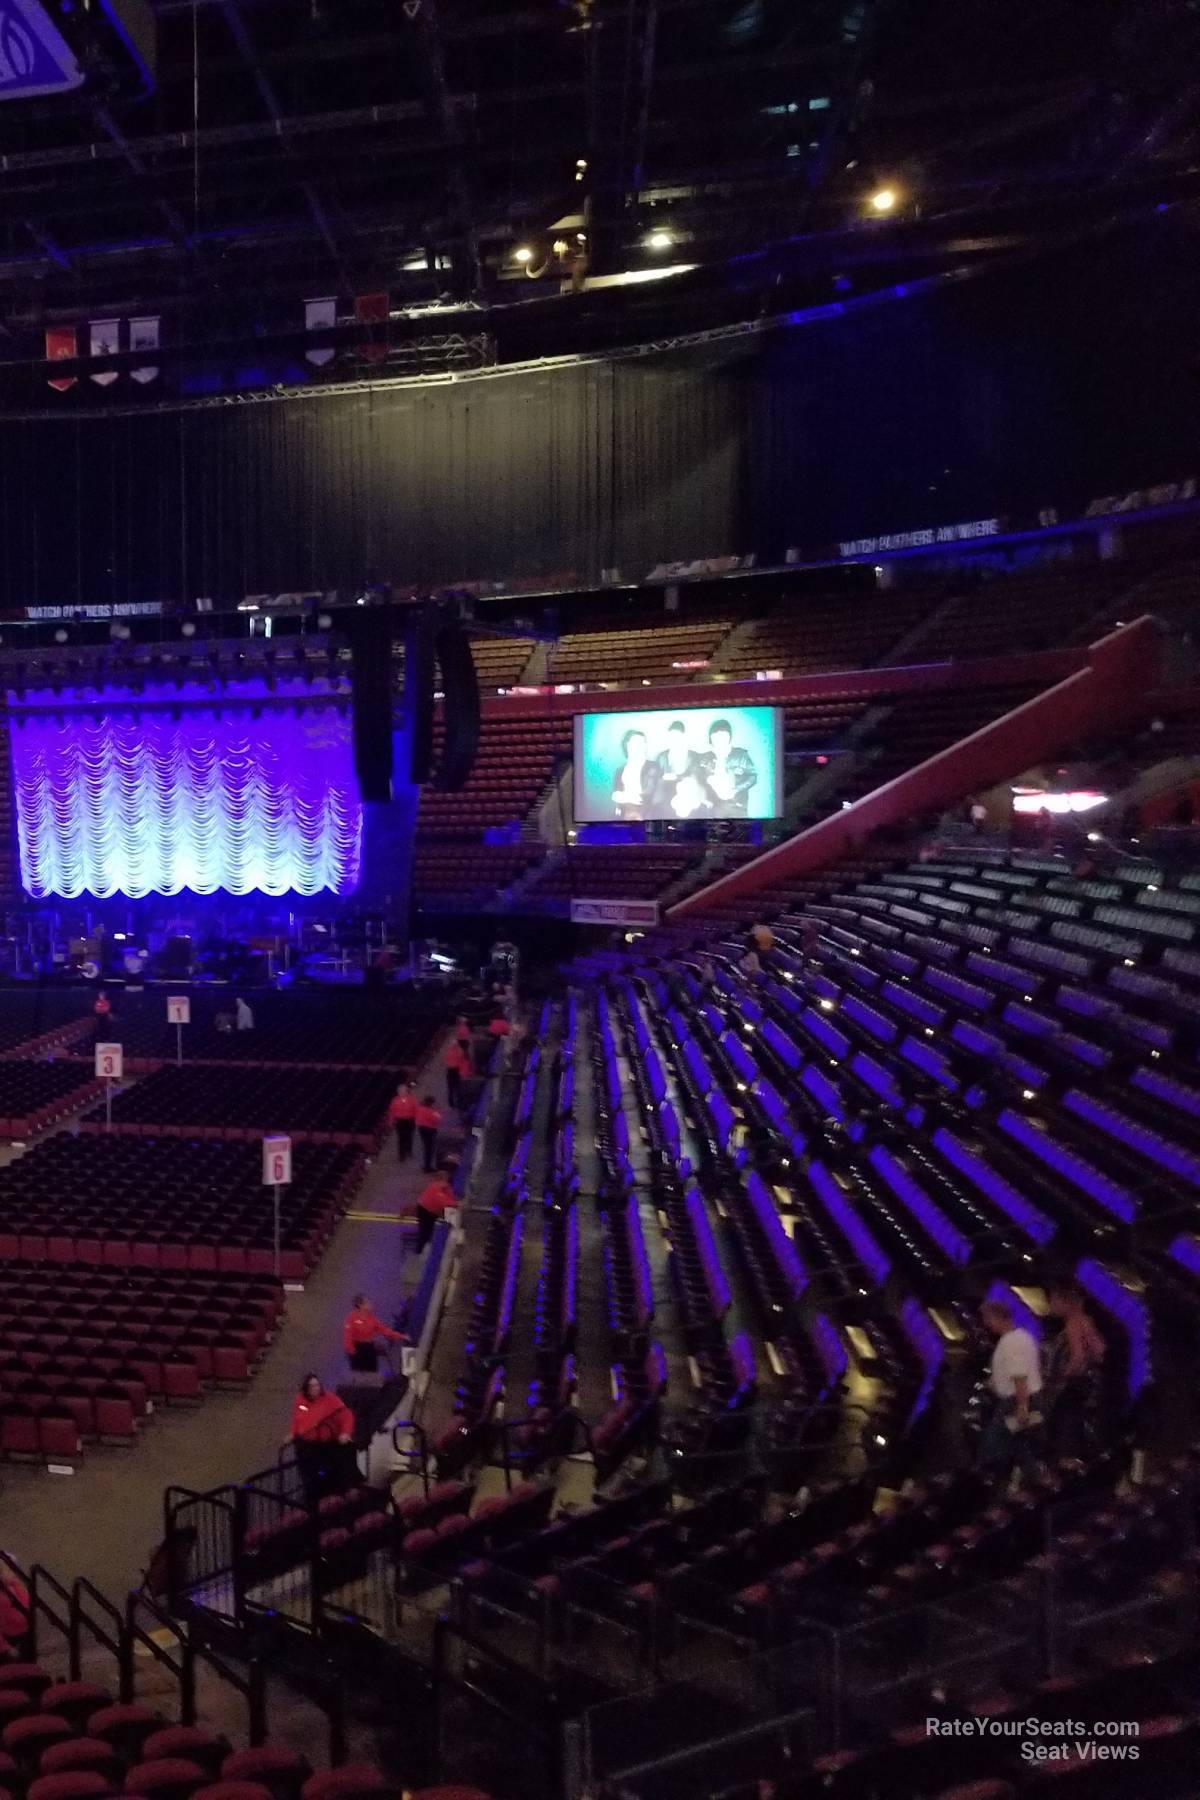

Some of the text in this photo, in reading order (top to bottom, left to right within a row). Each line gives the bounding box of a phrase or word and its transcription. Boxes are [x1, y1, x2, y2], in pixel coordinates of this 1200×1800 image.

[25, 605, 63, 618] WATCH
[104, 1056, 114, 1074] 3
[274, 1155, 283, 1181] 6
